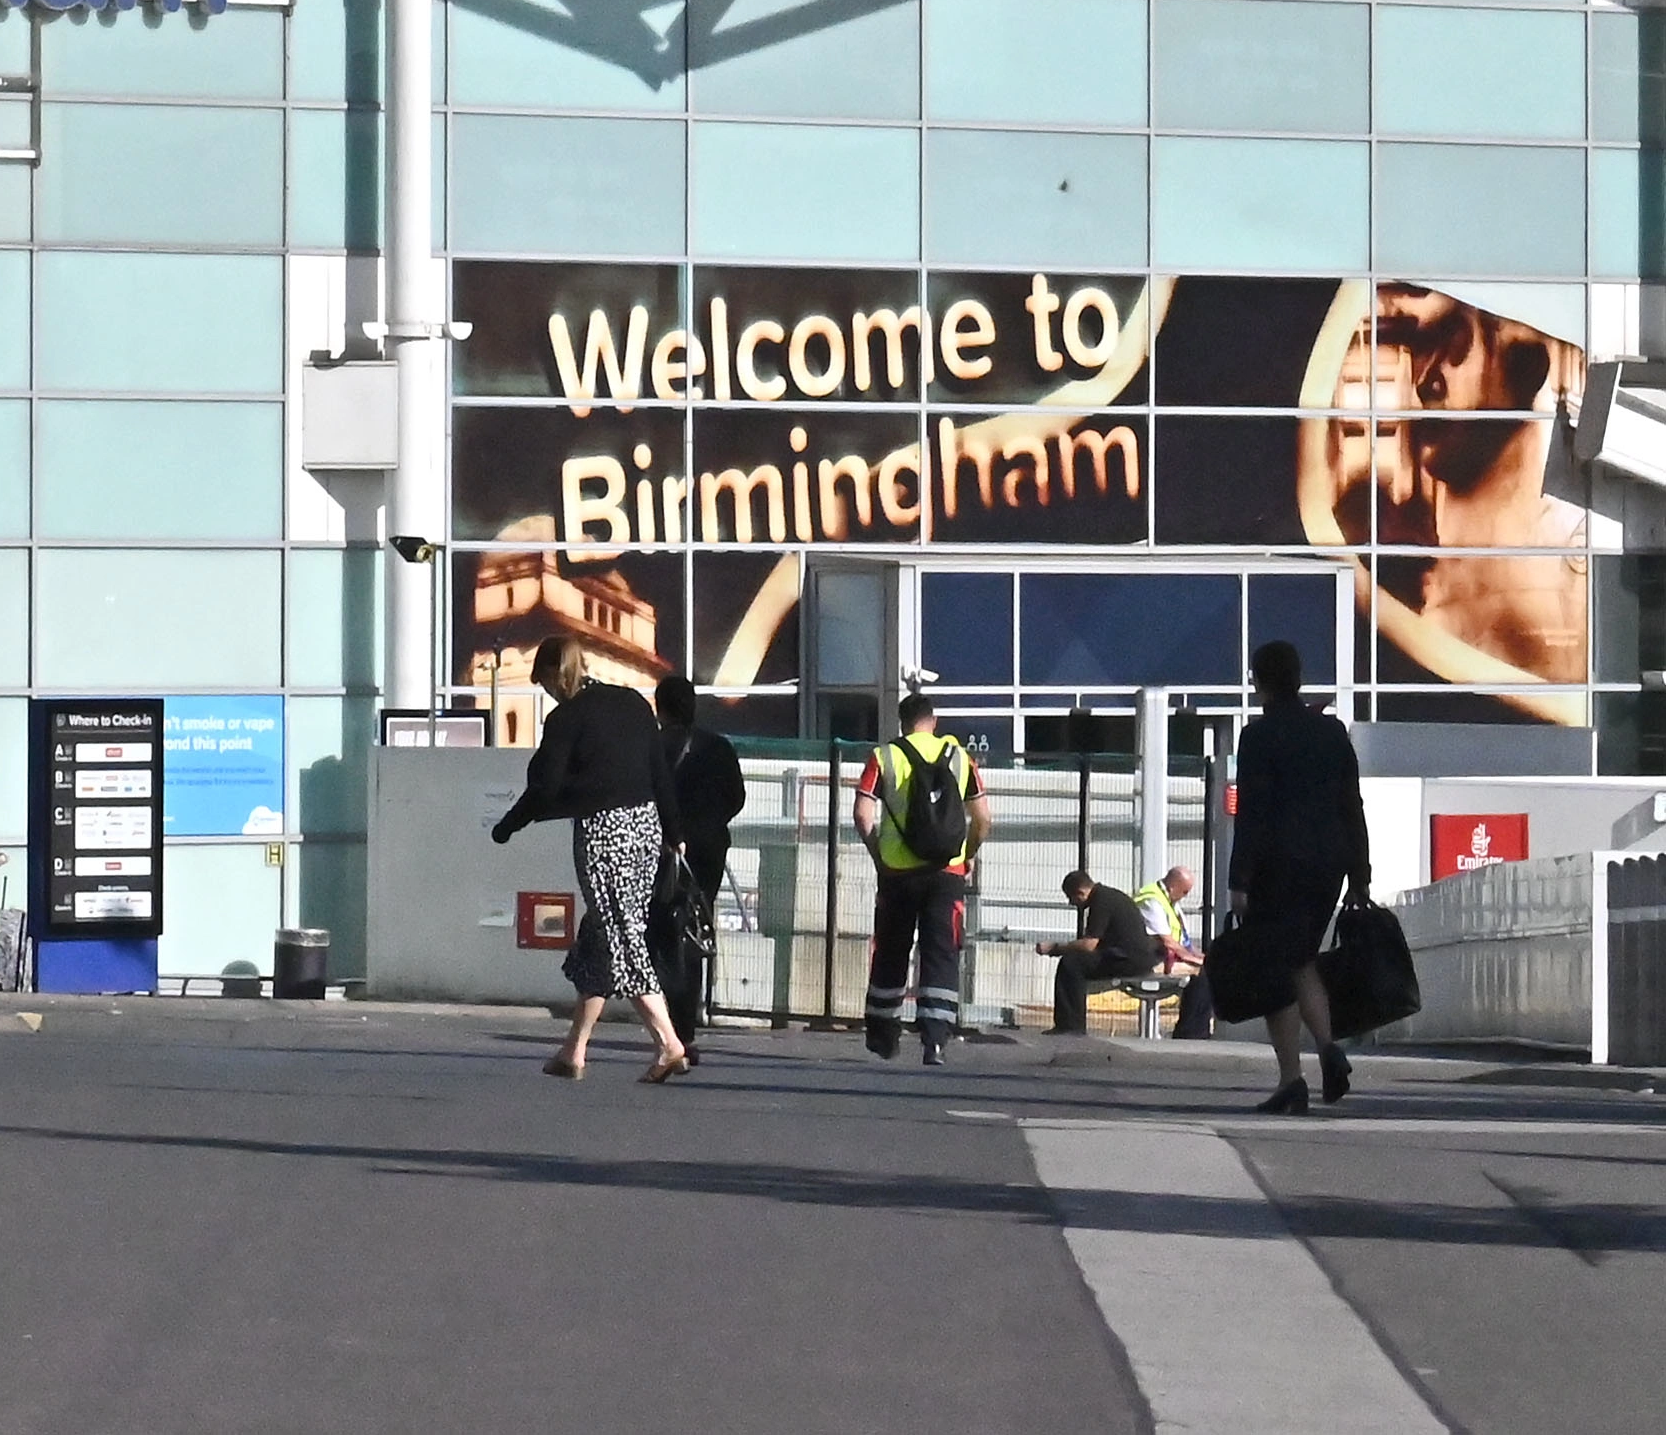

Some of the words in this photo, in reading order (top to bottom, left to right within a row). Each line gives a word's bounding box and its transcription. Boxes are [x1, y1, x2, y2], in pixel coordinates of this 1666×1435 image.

[547, 297, 997, 418] Welcome
[1024, 273, 1120, 372] to
[562, 415, 1140, 563] Birmingham
[69, 714, 99, 727] Where
[101, 715, 111, 726] to
[183, 715, 225, 730] smoke
[228, 718, 242, 730] or
[243, 718, 275, 733] vape
[164, 736, 190, 750] ond
[193, 735, 217, 751] this
[219, 736, 253, 754] point
